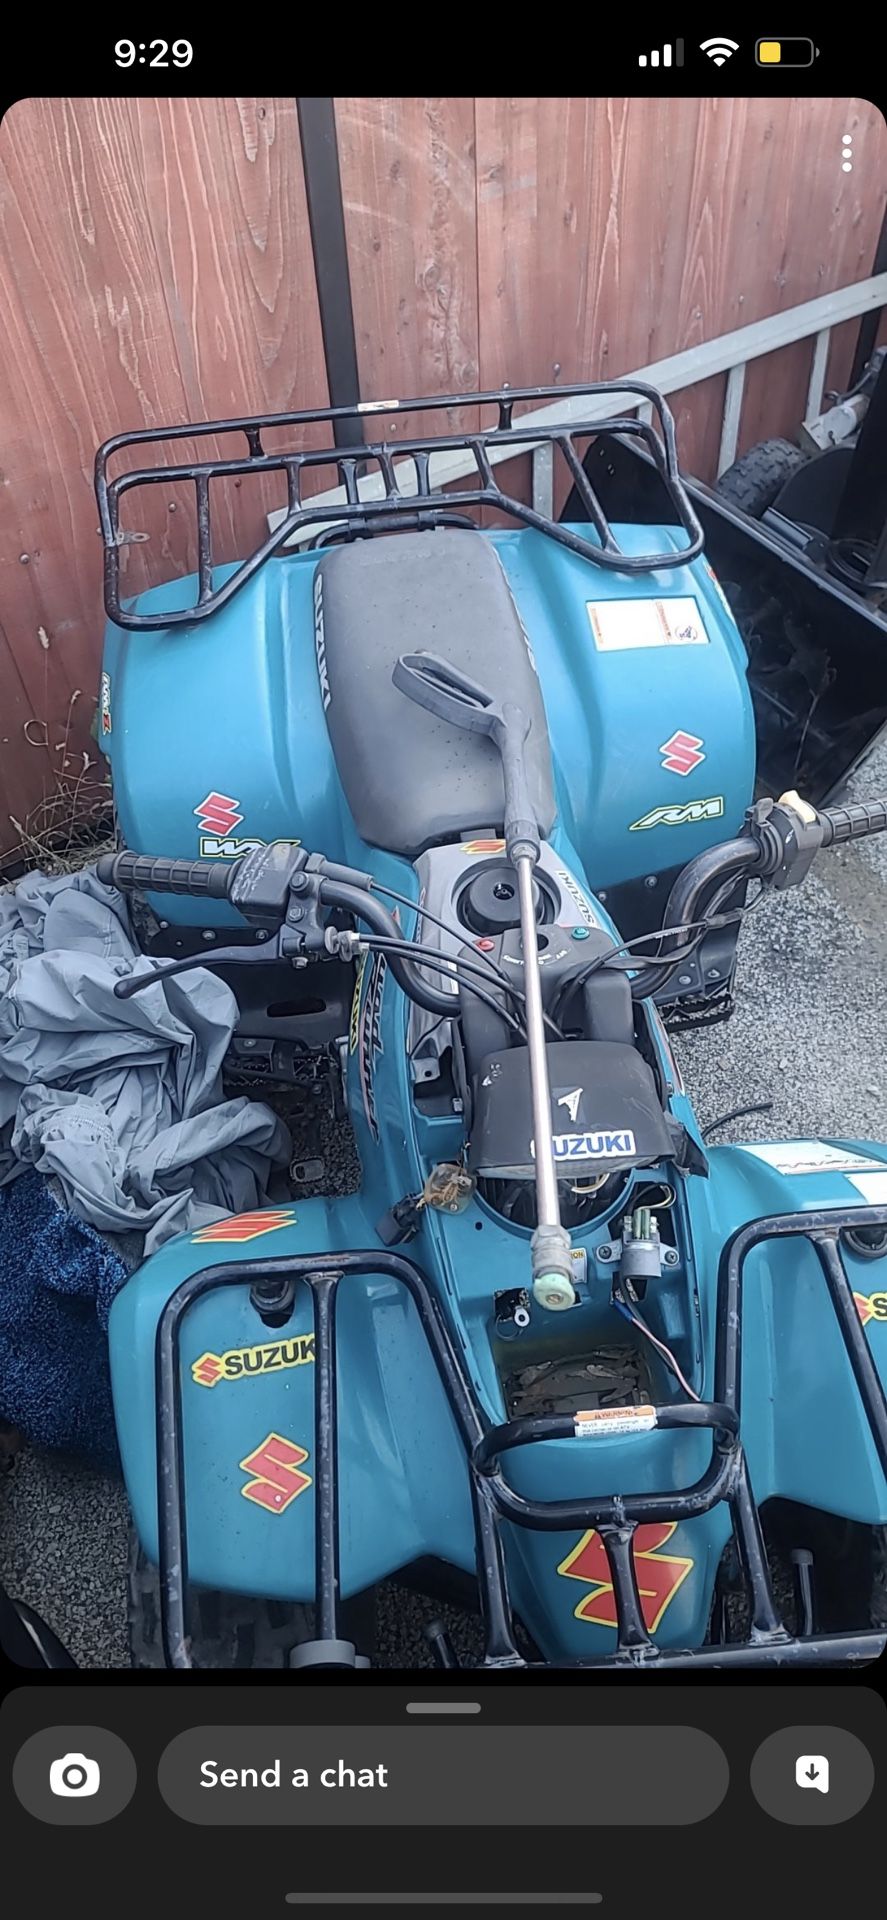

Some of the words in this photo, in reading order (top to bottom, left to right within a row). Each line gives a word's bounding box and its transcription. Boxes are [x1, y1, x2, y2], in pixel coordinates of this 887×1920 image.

[557, 872, 596, 924] SUZUKI
[552, 1134, 632, 1157] UZUKI
[224, 1338, 315, 1376] SUZUK
